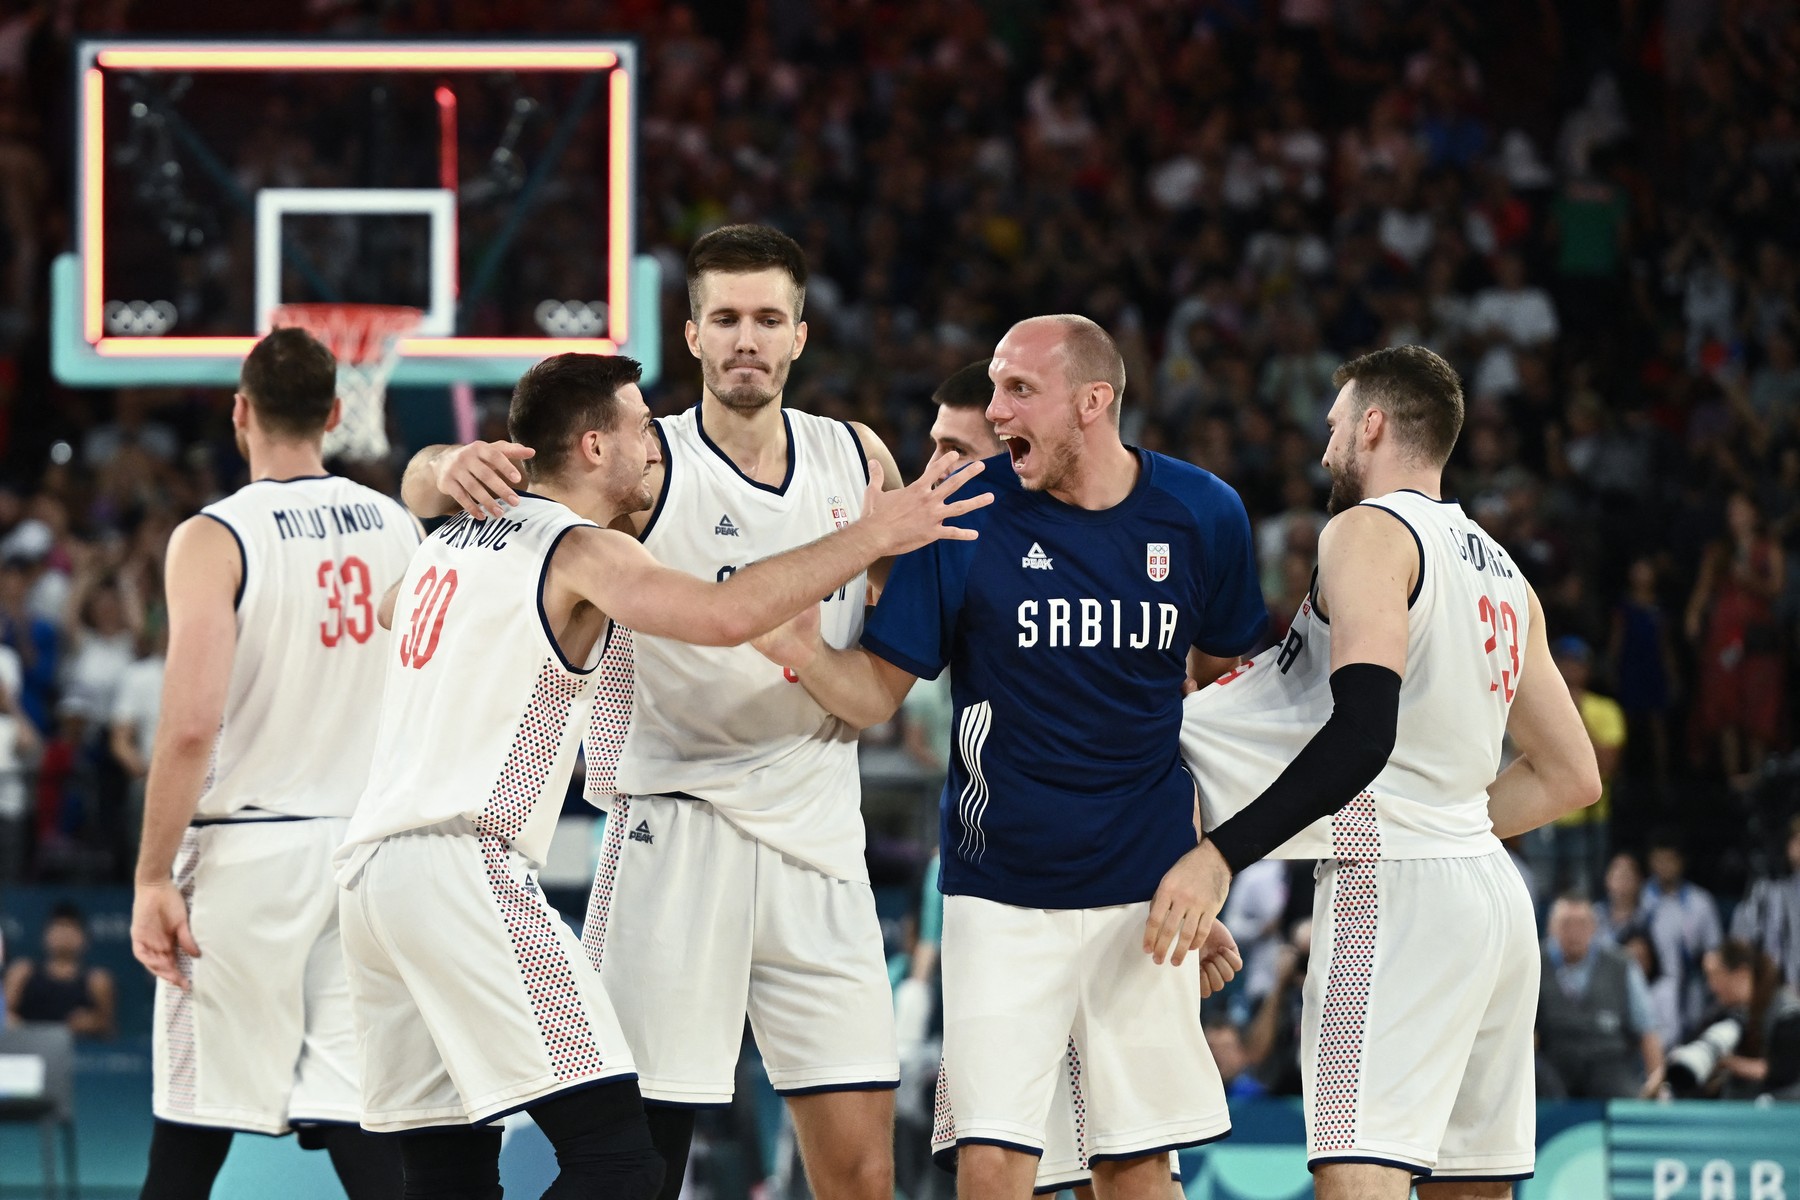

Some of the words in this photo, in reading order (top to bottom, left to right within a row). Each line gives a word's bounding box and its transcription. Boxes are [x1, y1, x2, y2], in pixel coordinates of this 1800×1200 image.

[273, 503, 384, 540] MILUINOV
[714, 526, 740, 538] PEAK
[1022, 556, 1054, 571] PEAK
[317, 555, 374, 647] 33
[399, 565, 458, 670] 30
[1017, 598, 1179, 651] SRBIJA
[628, 830, 655, 845] PEAK
